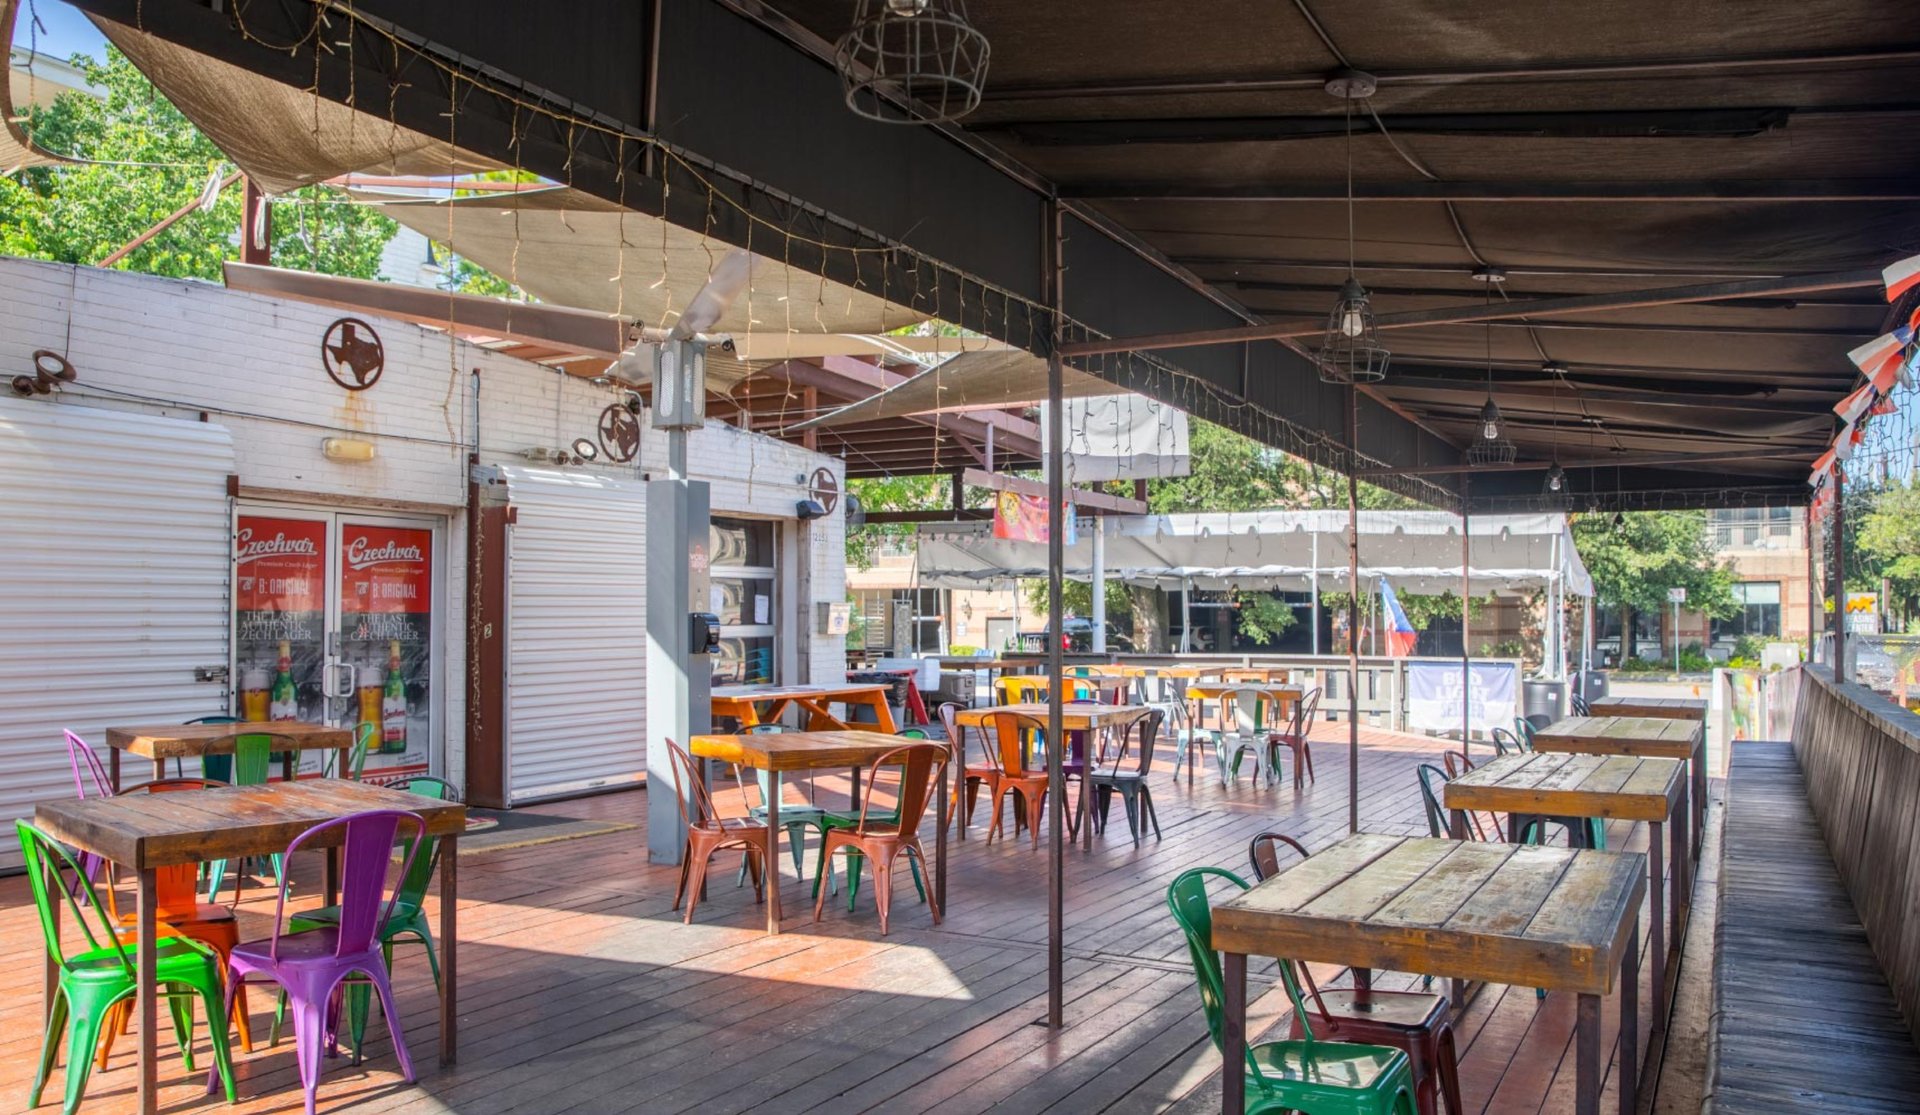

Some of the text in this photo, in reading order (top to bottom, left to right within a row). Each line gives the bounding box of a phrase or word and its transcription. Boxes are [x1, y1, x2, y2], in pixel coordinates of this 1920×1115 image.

[237, 527, 318, 564] Czechvar
[348, 536, 424, 570] Czechvar
[269, 578, 310, 595] ORIGINAL
[382, 583, 416, 598] ORIGINAL
[244, 610, 299, 621] THE LAST
[361, 613, 408, 623] THE LAST
[240, 629, 312, 641] ZECH LAGER
[386, 631, 419, 641] LAGER
